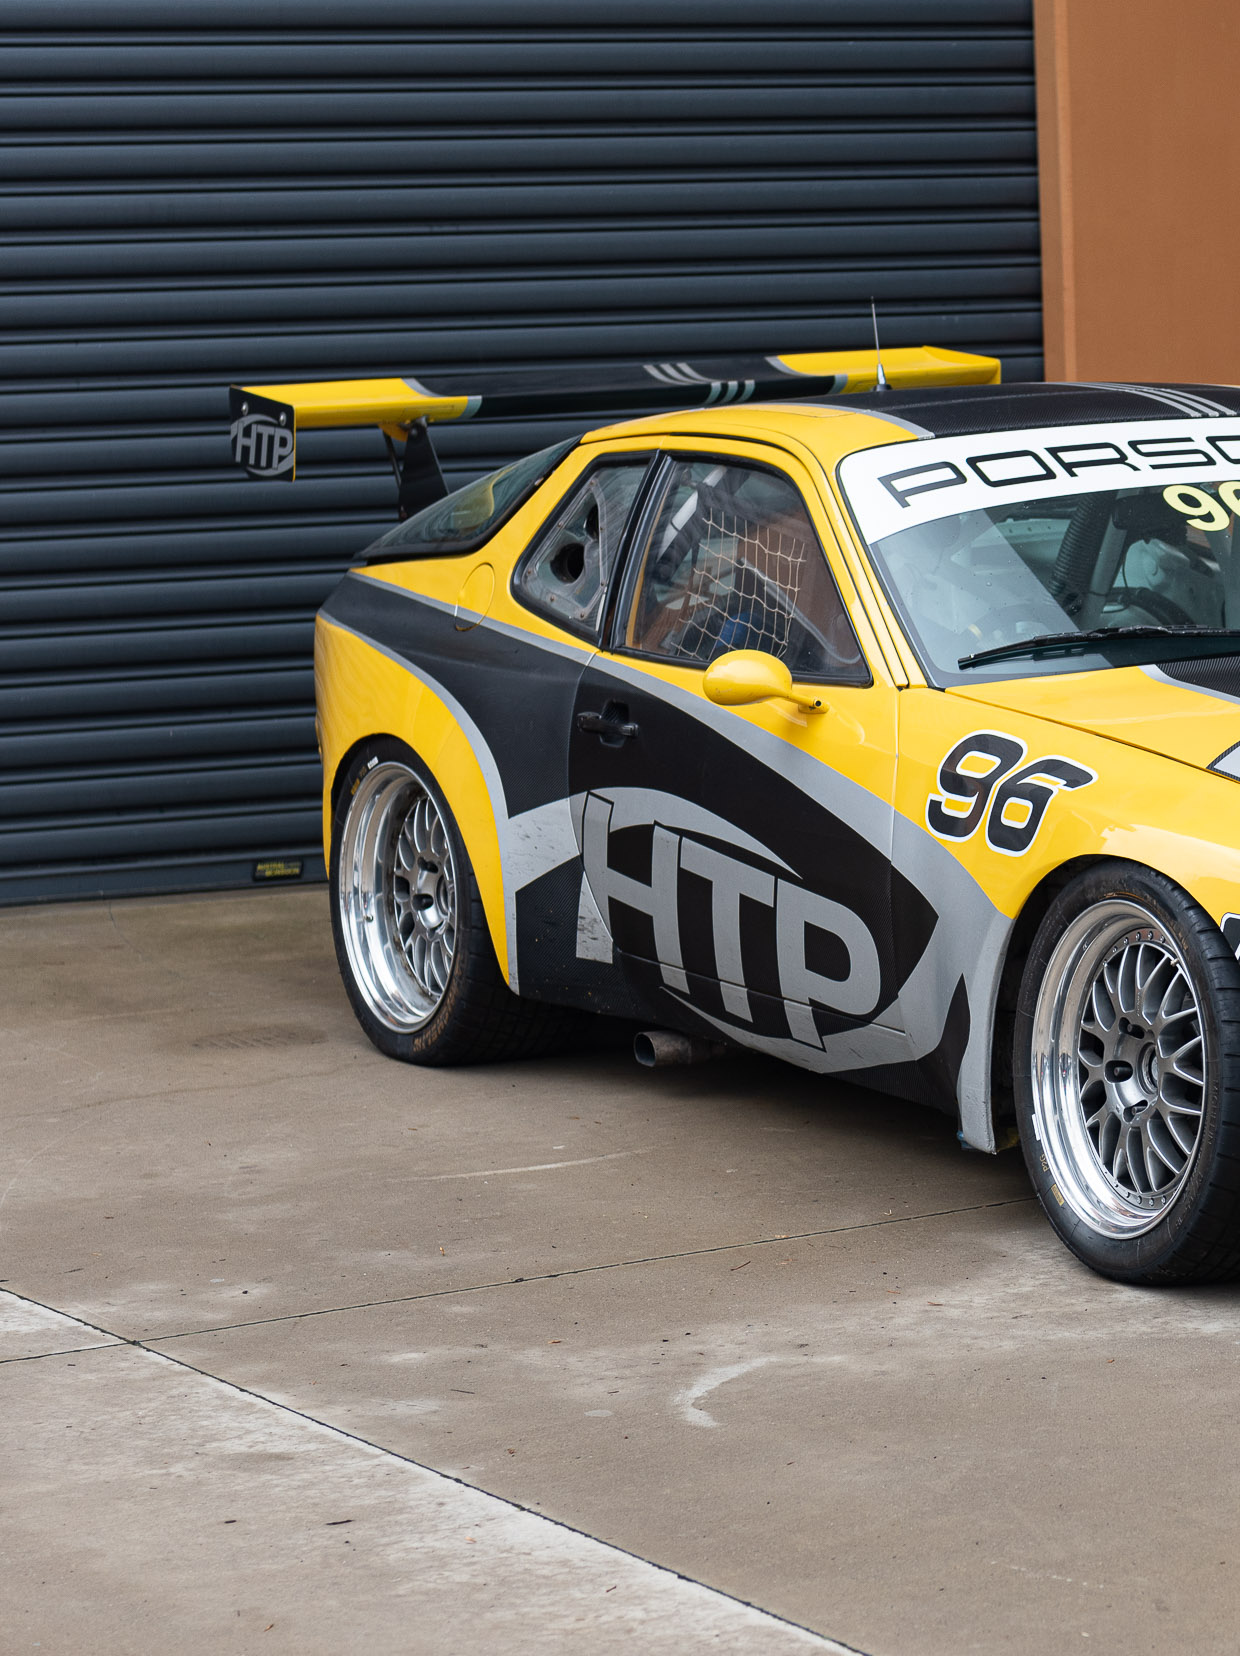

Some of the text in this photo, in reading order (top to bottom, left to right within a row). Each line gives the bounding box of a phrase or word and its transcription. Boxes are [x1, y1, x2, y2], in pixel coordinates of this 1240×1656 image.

[235, 420, 294, 470] HTP
[925, 729, 1098, 857] 96
[576, 790, 882, 1051] HTP
